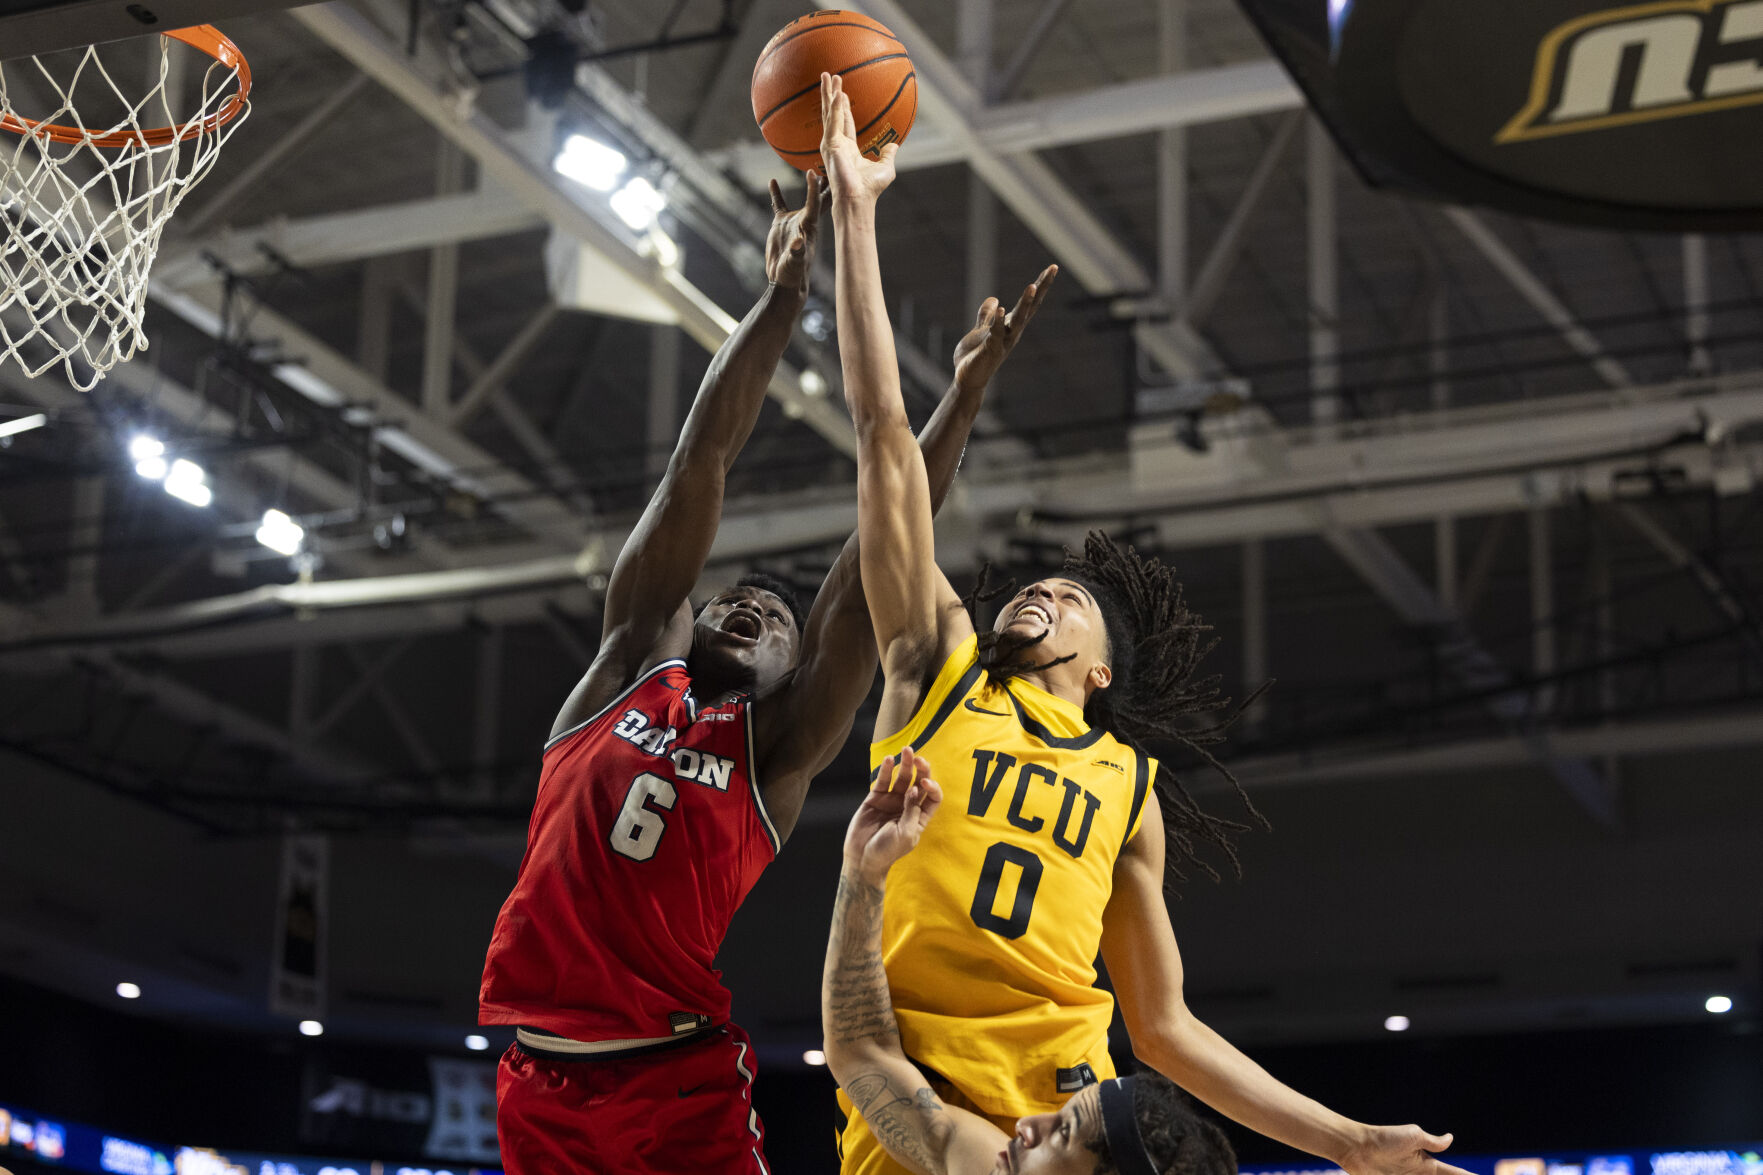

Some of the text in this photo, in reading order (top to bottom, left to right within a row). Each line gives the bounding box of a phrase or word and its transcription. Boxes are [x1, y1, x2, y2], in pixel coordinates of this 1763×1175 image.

[608, 771, 679, 863] 6
[967, 749, 1101, 858] VCU
[970, 841, 1044, 940] 0
